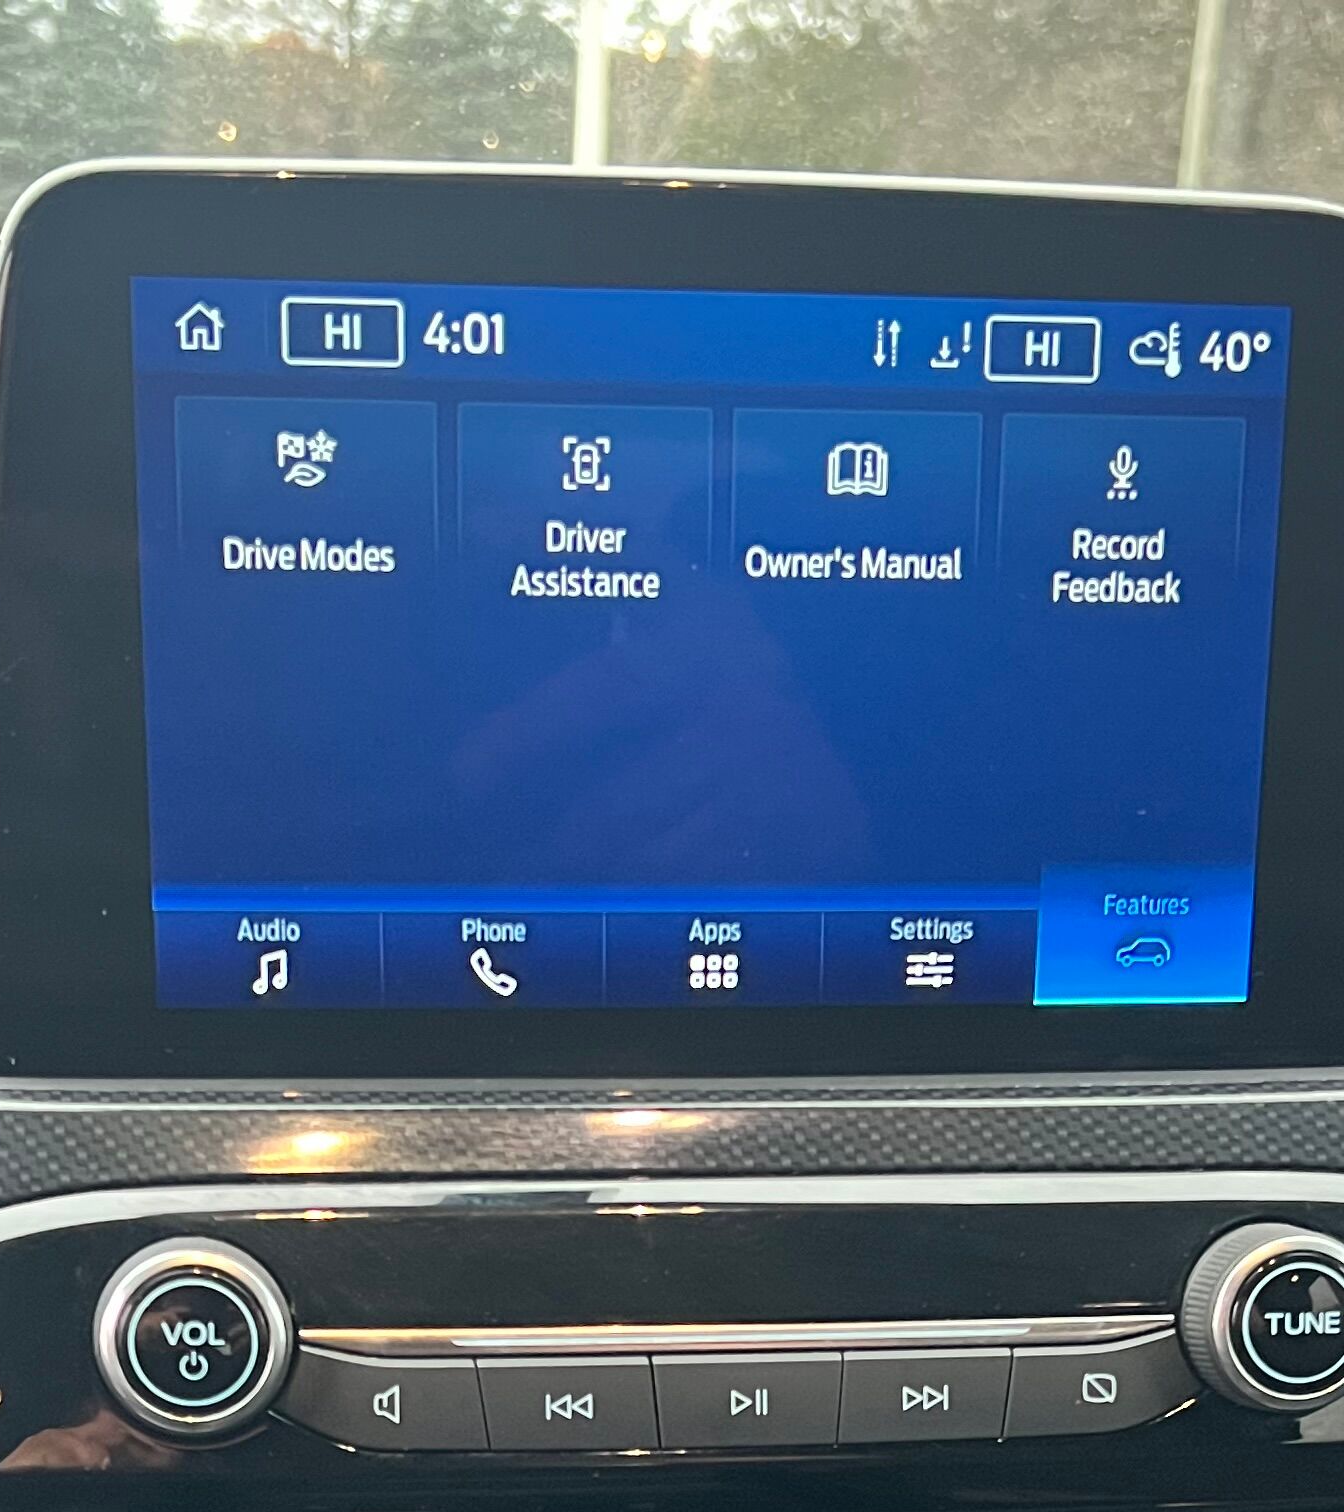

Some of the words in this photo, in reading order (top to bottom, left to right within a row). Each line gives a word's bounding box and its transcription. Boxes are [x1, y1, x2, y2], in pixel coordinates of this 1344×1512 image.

[323, 312, 361, 350] HI
[422, 310, 505, 355] 4:01
[1025, 329, 1061, 367] HI
[1199, 331, 1272, 372] 40°
[222, 536, 294, 570] Drive
[299, 538, 396, 572] Modes
[545, 520, 626, 554] Driver
[1072, 527, 1165, 561] Record
[744, 545, 856, 579] Owner's
[861, 546, 962, 581] Manual
[510, 564, 660, 599] Assistance
[1052, 570, 1181, 603] Feedback
[1103, 893, 1189, 916] Features
[236, 918, 300, 944] Audio
[461, 918, 526, 944] Phone
[688, 918, 741, 943] Apps
[889, 916, 974, 943] Settings
[160, 1322, 225, 1347] VOL
[1264, 1310, 1341, 1336] TUNE
